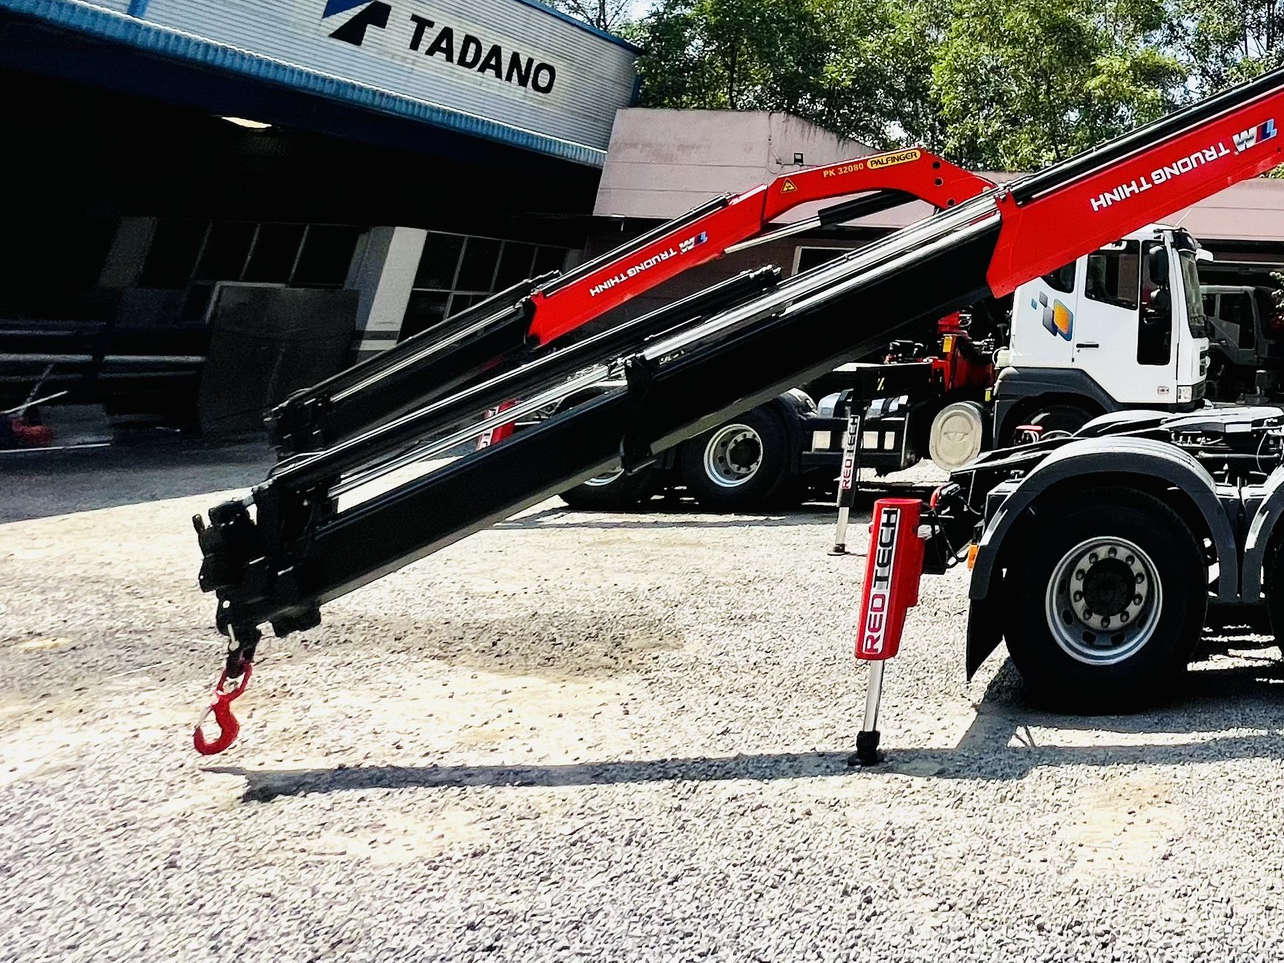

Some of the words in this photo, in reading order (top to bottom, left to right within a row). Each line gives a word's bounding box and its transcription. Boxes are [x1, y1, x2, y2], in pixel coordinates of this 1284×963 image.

[410, 13, 557, 94] TADANO
[870, 151, 918, 168] PALFINGER
[823, 168, 836, 178] PK
[838, 163, 864, 175] 32080
